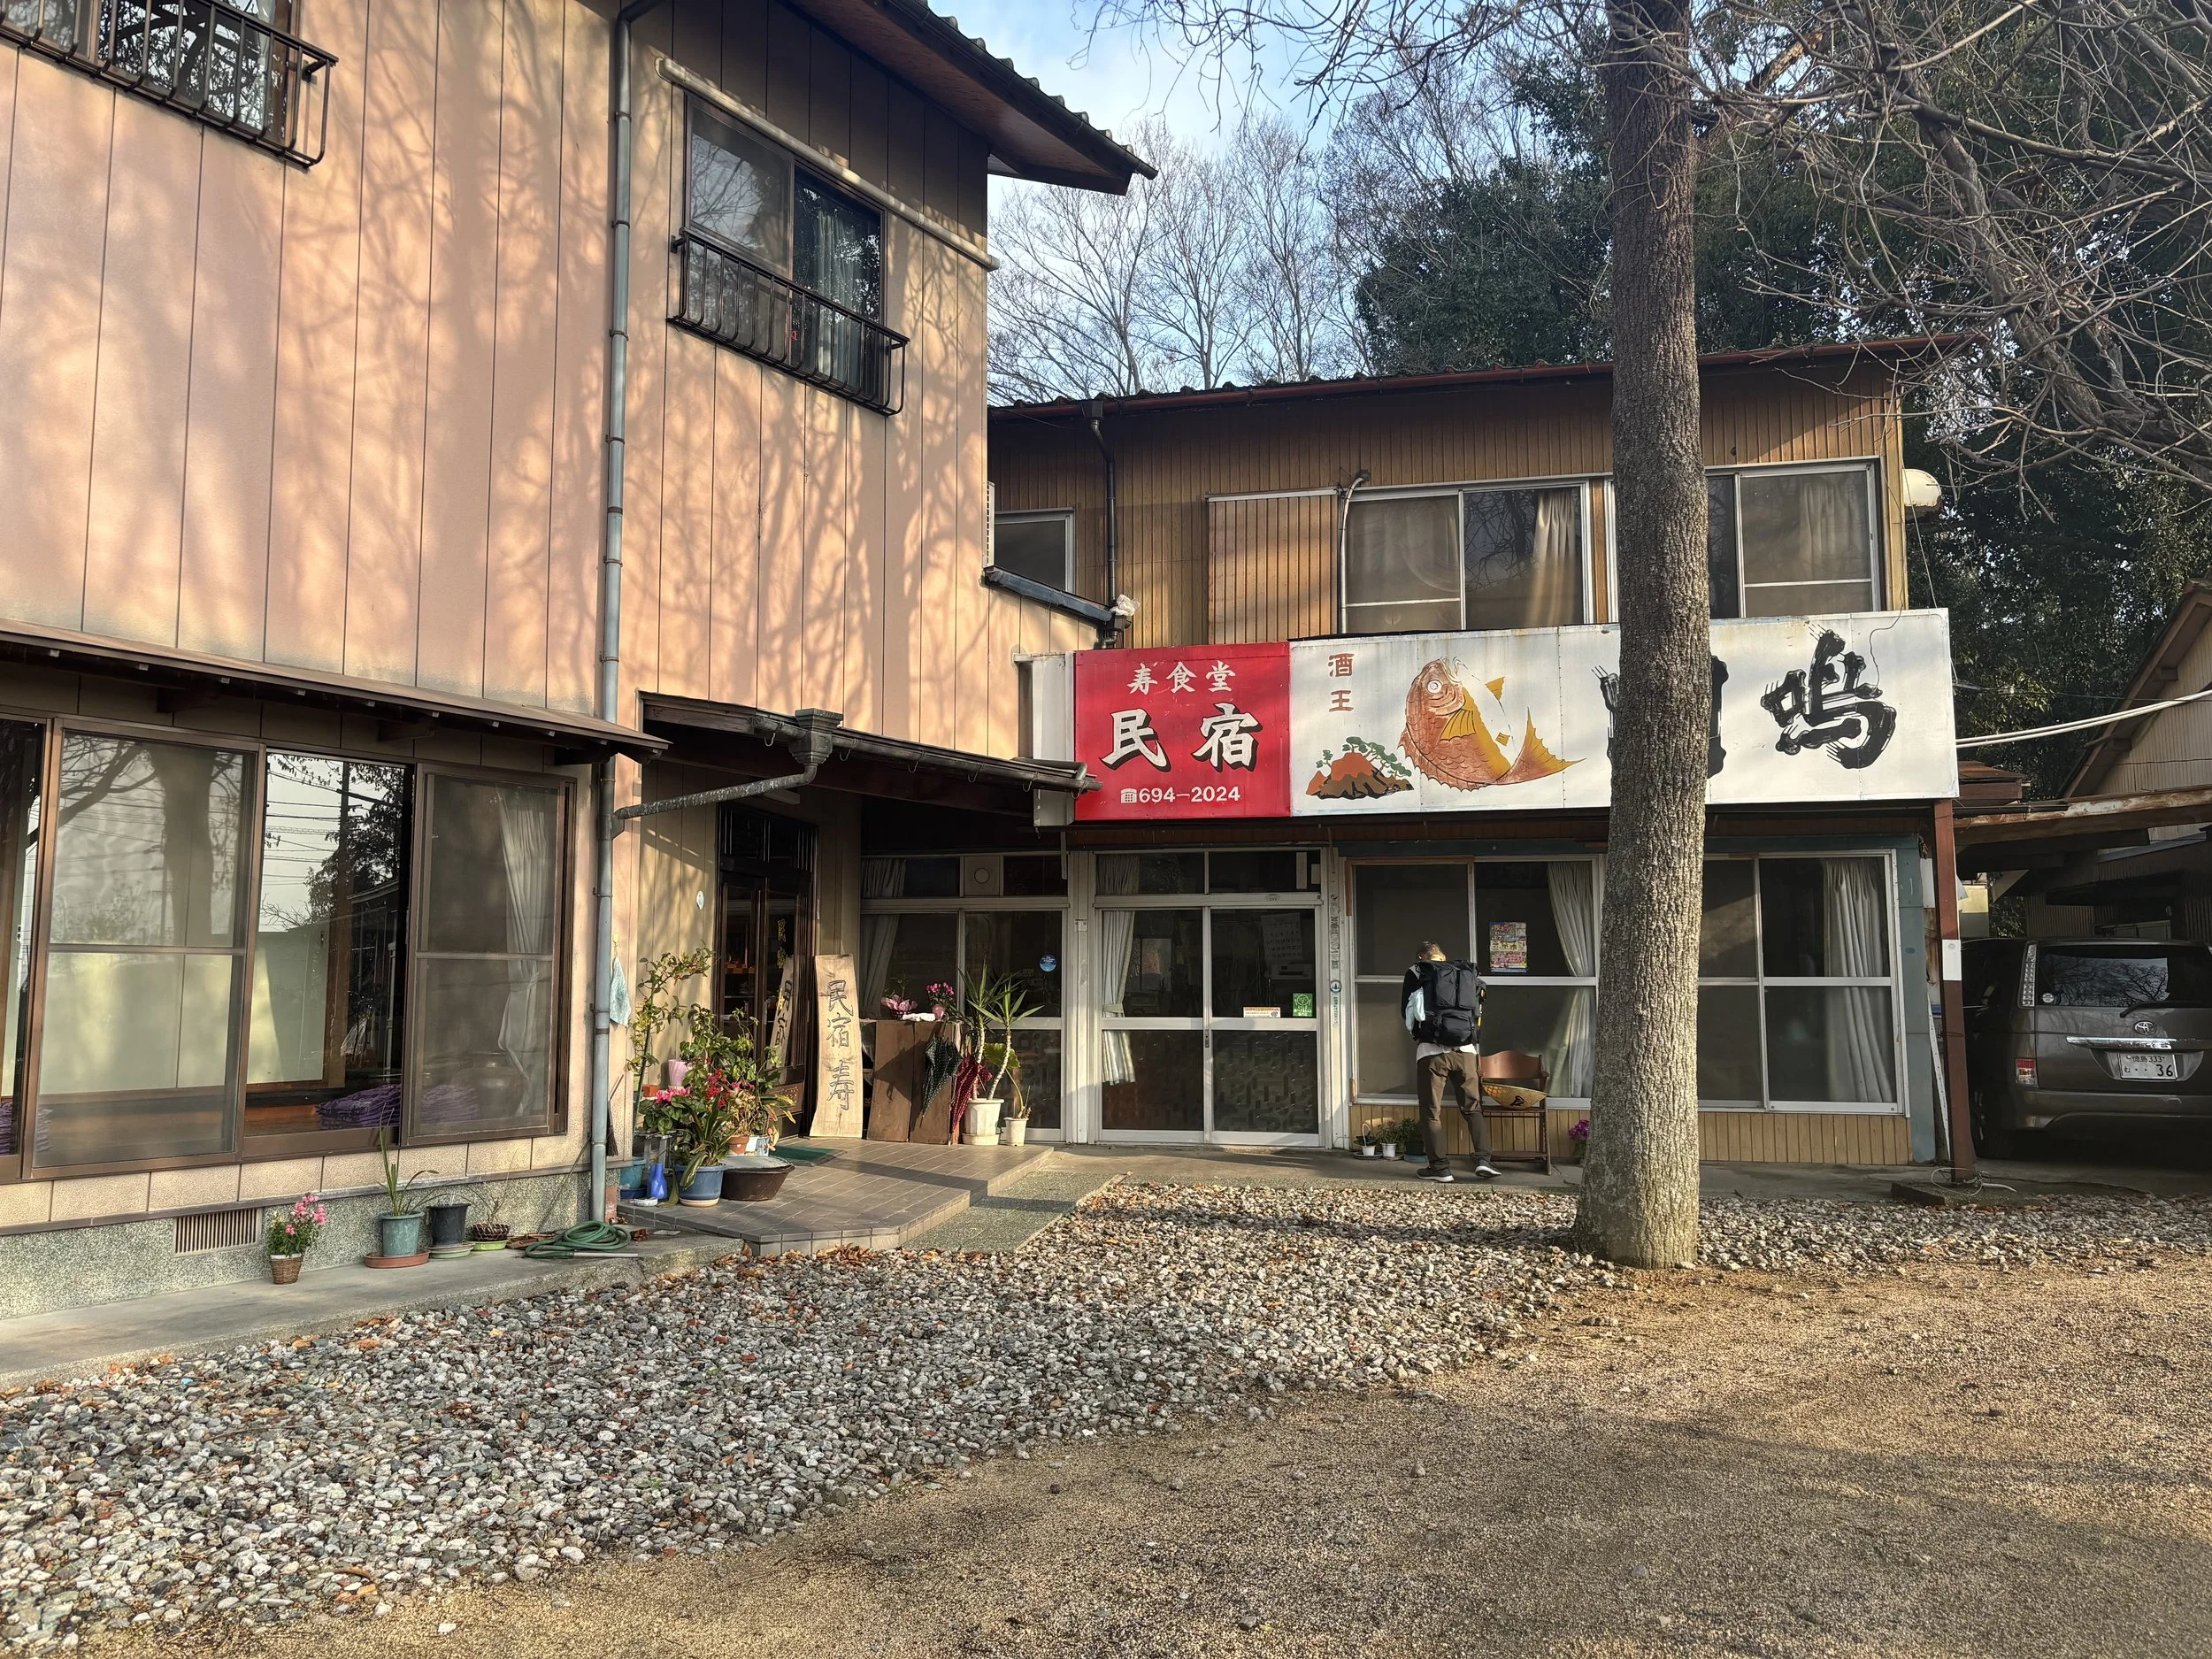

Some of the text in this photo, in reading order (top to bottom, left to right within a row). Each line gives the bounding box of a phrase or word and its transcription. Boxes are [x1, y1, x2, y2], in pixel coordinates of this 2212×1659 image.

[1126, 659, 1237, 695] 寿食堂
[1328, 653, 1355, 713] 酒王
[1099, 702, 1264, 773] 民宿
[826, 979, 857, 1111] 民宿寿
